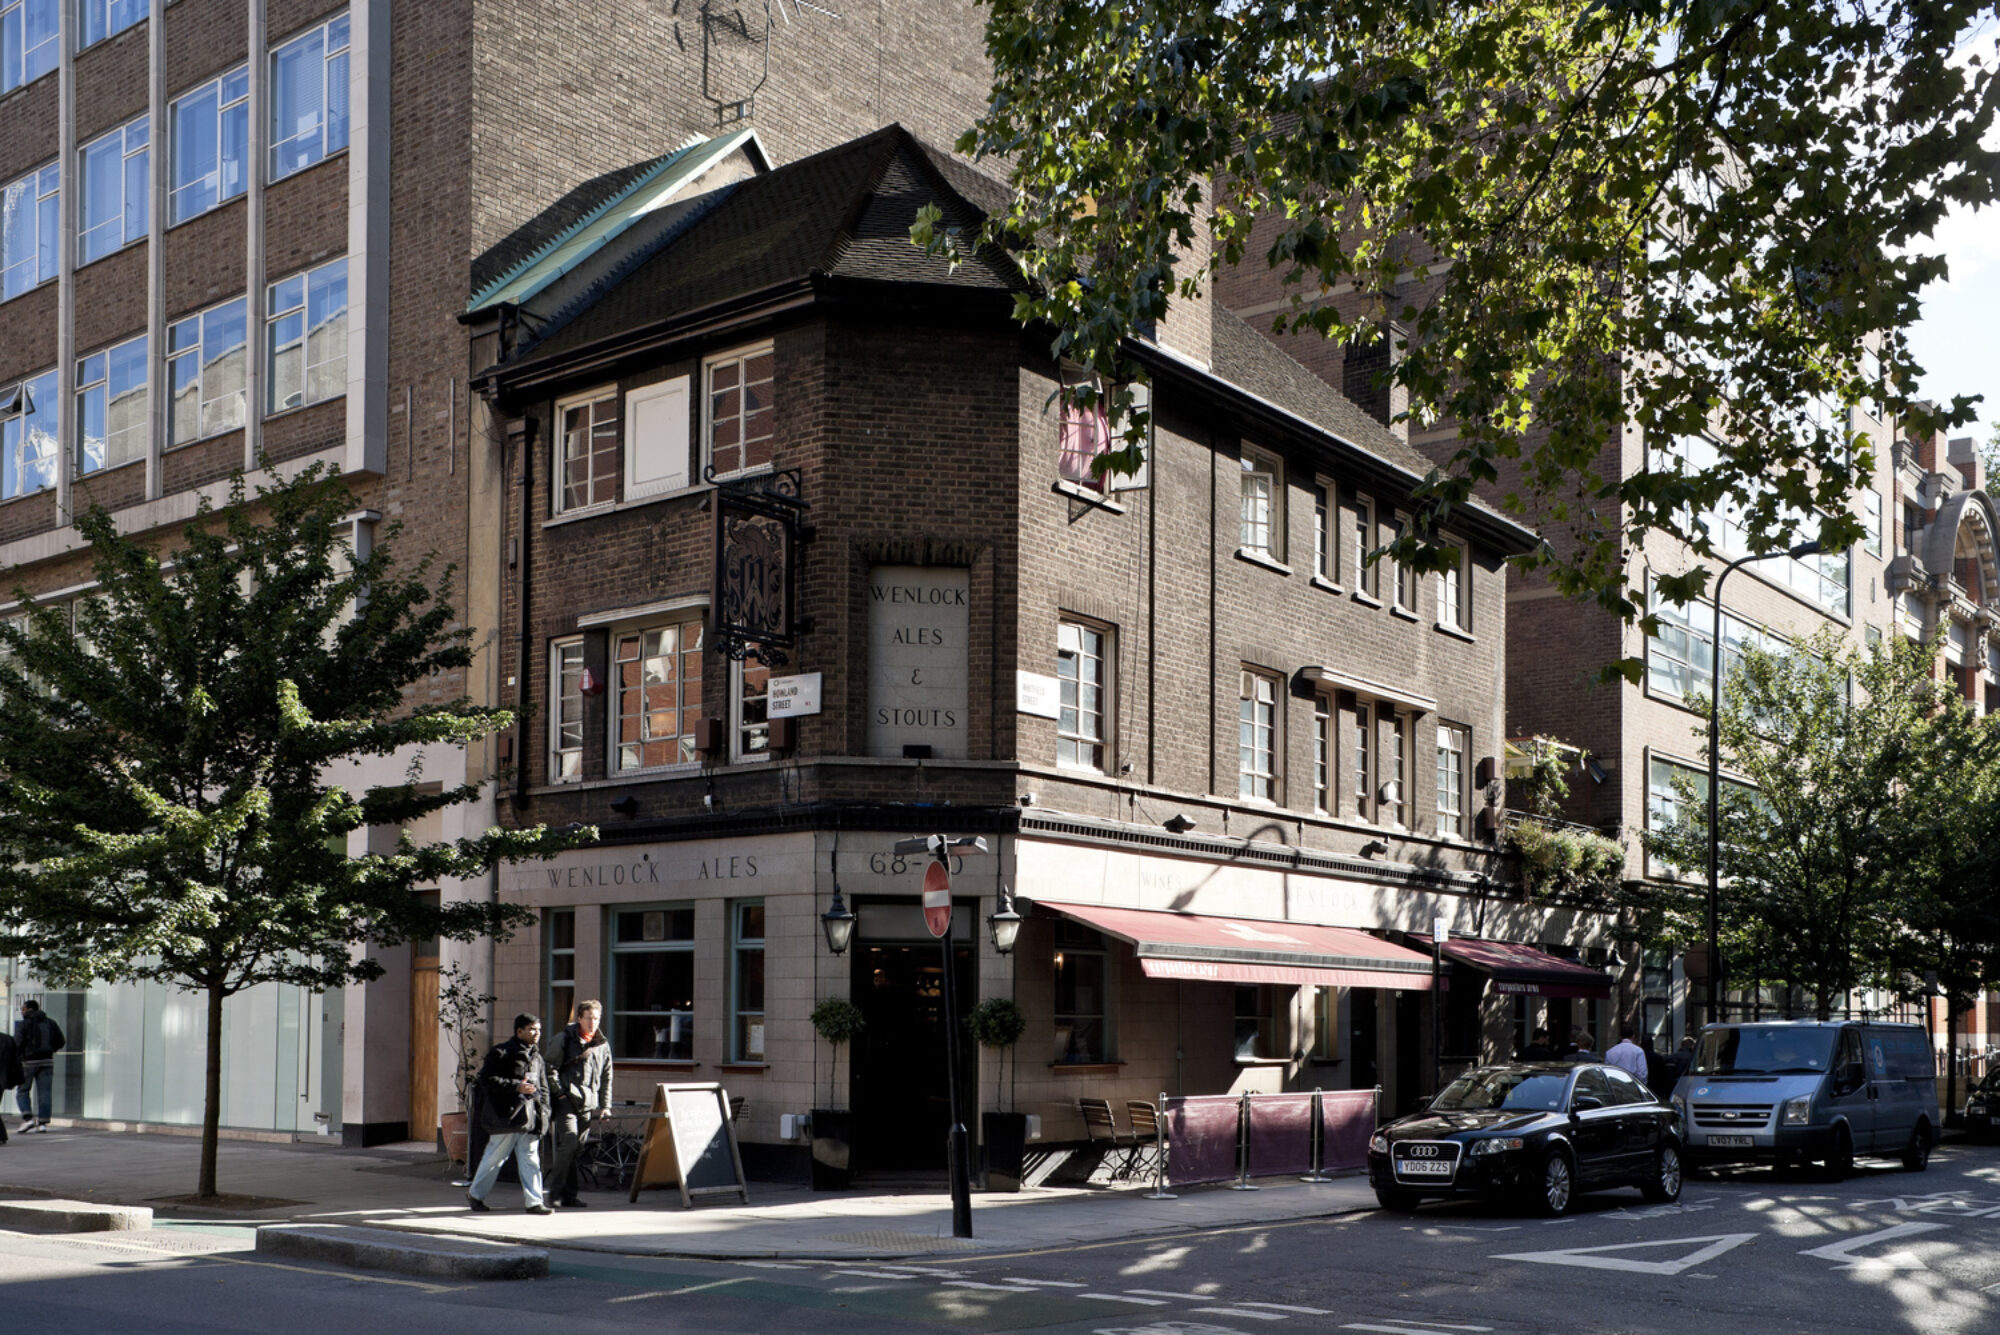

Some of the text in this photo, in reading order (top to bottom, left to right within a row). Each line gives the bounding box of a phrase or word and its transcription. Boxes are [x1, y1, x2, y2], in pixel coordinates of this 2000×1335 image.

[869, 585, 965, 606] WENLOCK
[892, 627, 943, 646] ALES
[772, 686, 798, 698] HOWLAND
[772, 699, 791, 710] STREET
[876, 707, 956, 728] STOUTS
[547, 855, 758, 888] WENLOCK ALES
[1404, 1160, 1449, 1172] YD06 ZZS
